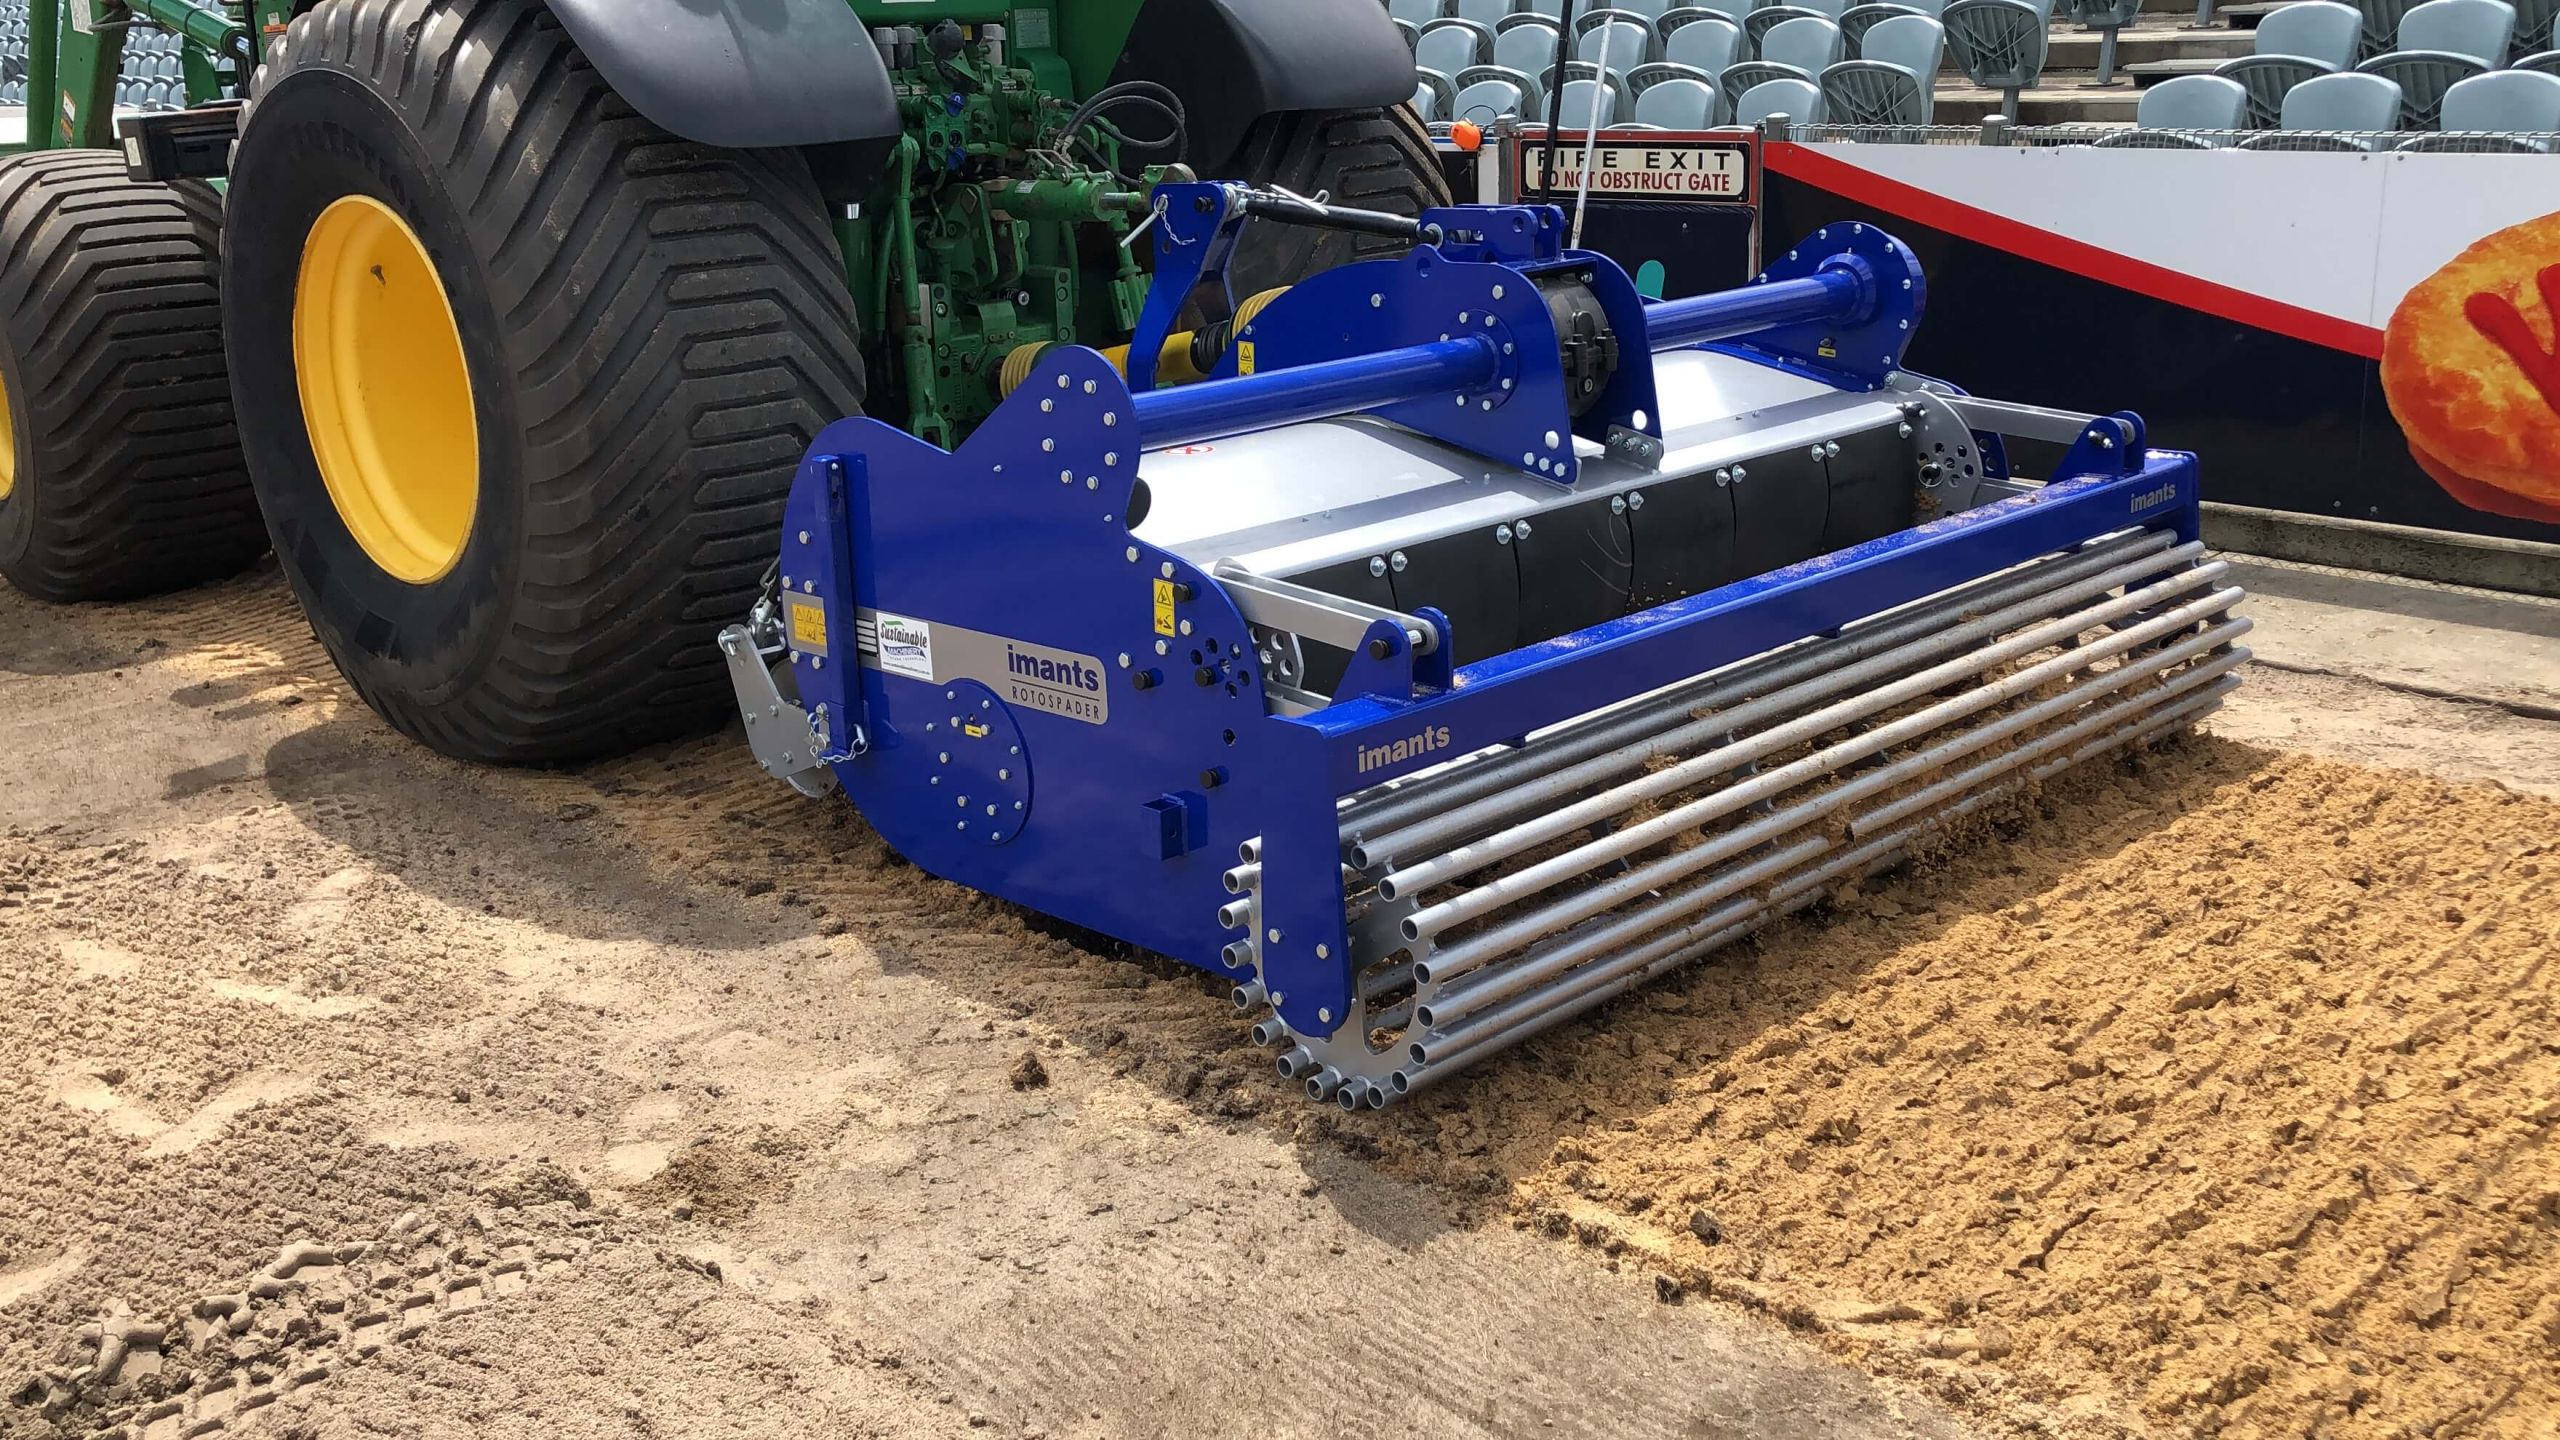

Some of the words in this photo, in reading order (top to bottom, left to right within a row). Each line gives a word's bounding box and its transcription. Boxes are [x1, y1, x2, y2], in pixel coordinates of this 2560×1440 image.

[1645, 151, 1731, 170] EXIT
[1600, 172, 1683, 191] OBSTRUCT
[1688, 173, 1730, 192] GATE
[2130, 482, 2177, 513] imants
[880, 622, 928, 648] Sustainable
[1007, 643, 1099, 692] imants
[1011, 685, 1100, 720] ROTOSPADER
[1358, 725, 1450, 774] imants
